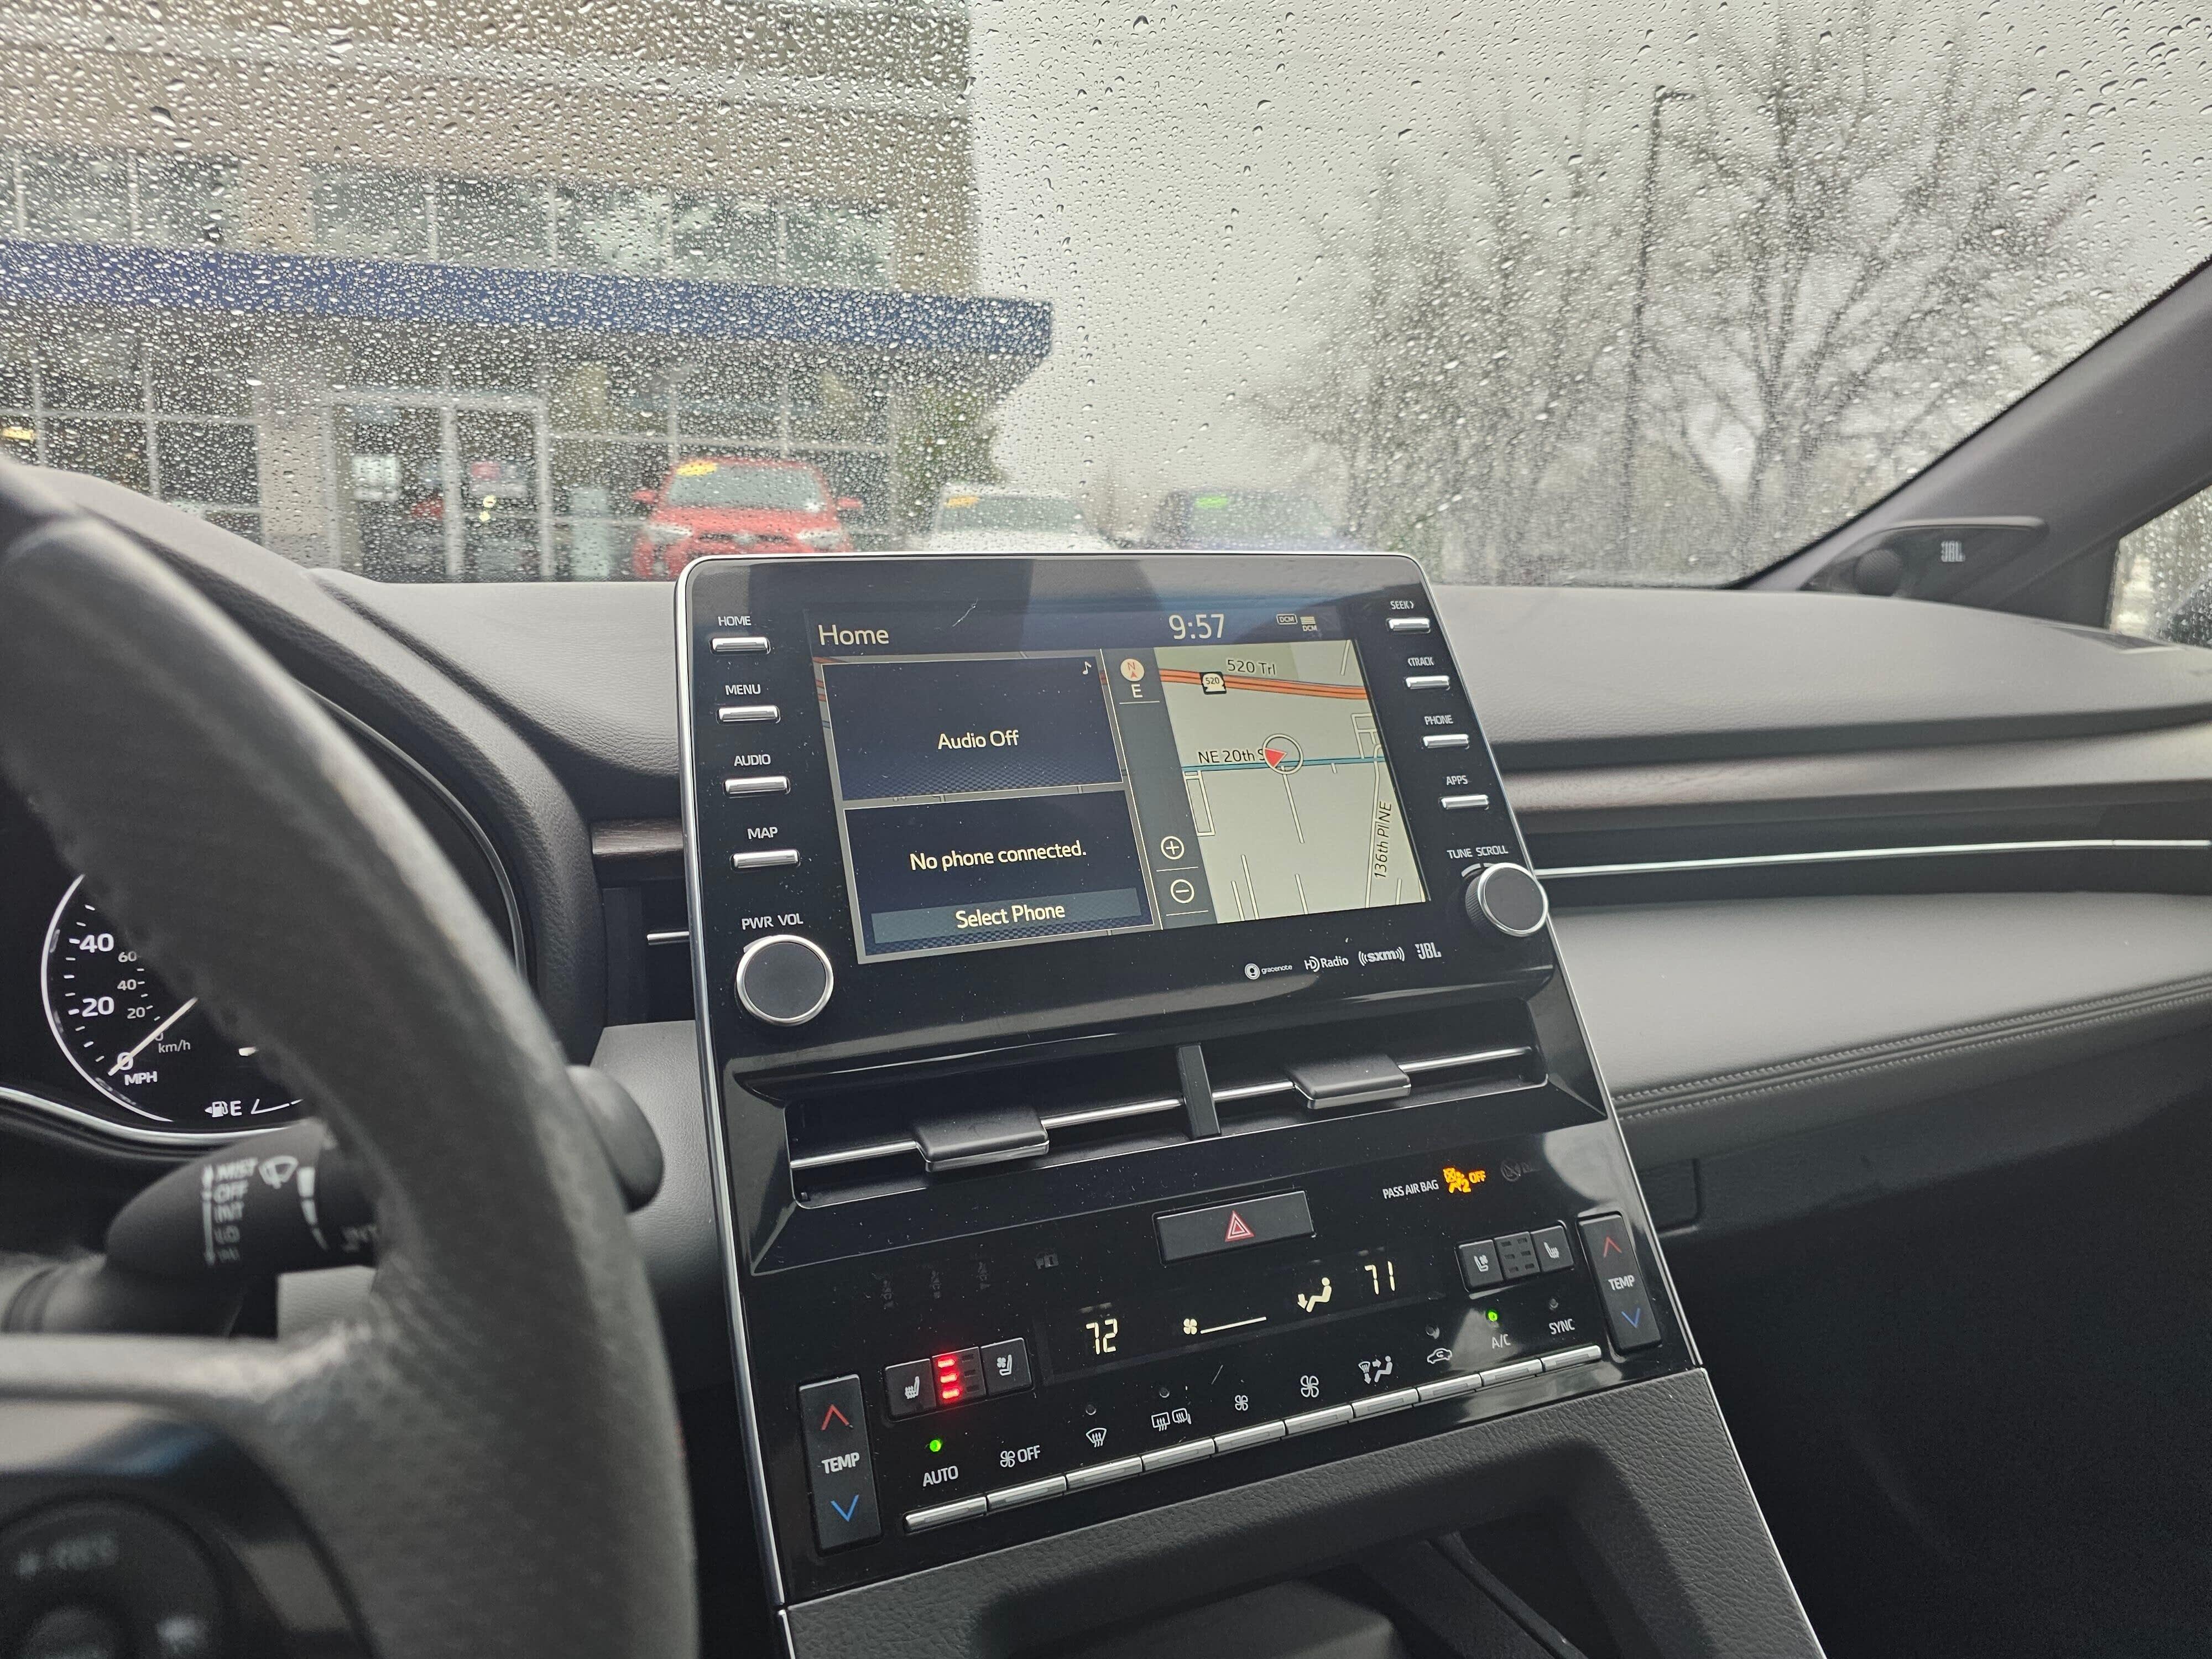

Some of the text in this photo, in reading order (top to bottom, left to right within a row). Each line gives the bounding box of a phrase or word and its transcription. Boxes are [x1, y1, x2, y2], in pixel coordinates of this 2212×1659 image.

[717, 615, 752, 627] HOME
[1168, 613, 1225, 640] 9:57
[818, 624, 890, 646] Home
[1127, 661, 1136, 671] N
[1227, 659, 1255, 673] 520
[724, 683, 761, 696] MENU
[1131, 684, 1144, 698] E
[1424, 714, 1454, 726] PHONE
[937, 729, 1020, 750] Audio Off
[733, 753, 771, 767] AUDIO
[1198, 750, 1220, 764] NE
[1223, 749, 1255, 763] 20th
[1446, 775, 1469, 786] APPS
[1379, 801, 1392, 823] NE
[747, 826, 779, 840] MAP
[909, 839, 1087, 872] No phone connected.
[1374, 841, 1389, 878] 136th
[1446, 844, 1509, 859] TUNE SCROLL
[741, 912, 804, 931] PWR VOL
[955, 904, 1066, 929] Select Phone
[79, 933, 114, 953] 40
[1415, 942, 1442, 959] JBL
[118, 951, 137, 963] 60
[1320, 956, 1349, 968] Radio
[1261, 964, 1293, 974] gracenote
[117, 978, 137, 991] 40
[82, 996, 115, 1018] 20
[127, 1006, 146, 1019] 20
[158, 1039, 191, 1053] km/h
[124, 1071, 158, 1086] MPH
[230, 1100, 242, 1117] E
[1469, 1170, 1486, 1183] OFF
[1383, 1180, 1439, 1199] PASS AIR BAG
[1364, 1261, 1396, 1295] 71
[1607, 1274, 1636, 1291] TEMP
[1549, 1319, 1575, 1335] SYNC
[1086, 1318, 1118, 1355] 72
[1491, 1333, 1512, 1349] A/C
[1017, 1444, 1041, 1464] OFF
[821, 1452, 860, 1474] TEMP
[922, 1465, 959, 1488] AUTO
